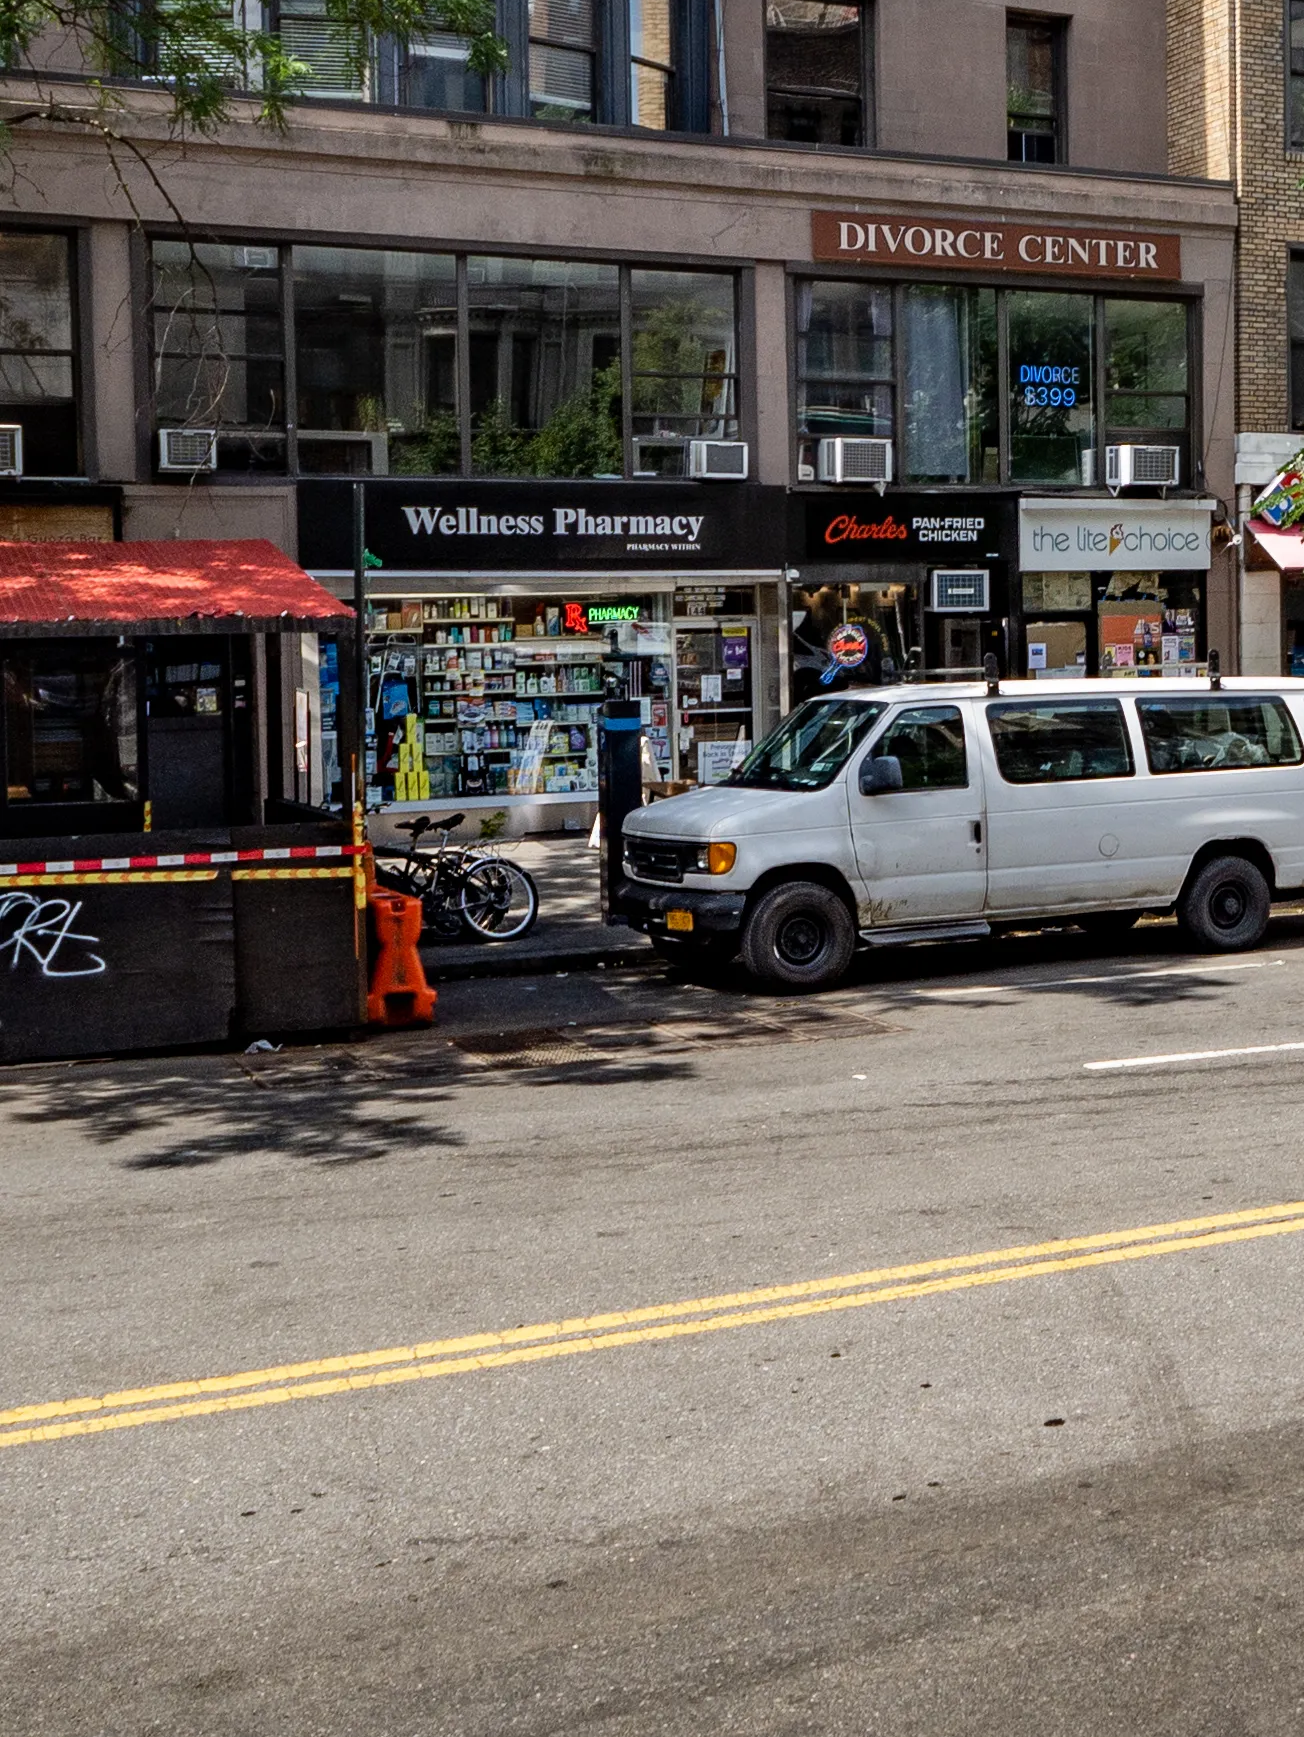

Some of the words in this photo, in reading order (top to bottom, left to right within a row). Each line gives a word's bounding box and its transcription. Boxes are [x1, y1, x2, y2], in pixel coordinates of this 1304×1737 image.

[837, 221, 1004, 260] DIVORCE
[1018, 234, 1159, 269] CENTER
[1020, 364, 1080, 385] DIVORCE
[1024, 385, 1076, 407] $399
[401, 506, 545, 535] Wellness
[552, 507, 704, 541] Pharmacy
[824, 515, 907, 544] Charles
[627, 542, 670, 551] PHARMACY
[671, 542, 701, 551] WITHIN
[918, 530, 978, 542] CHICKEN
[1032, 525, 1070, 552] the
[1077, 525, 1108, 552] lite
[1124, 525, 1200, 552] choice
[588, 605, 639, 620] PHARMACY
